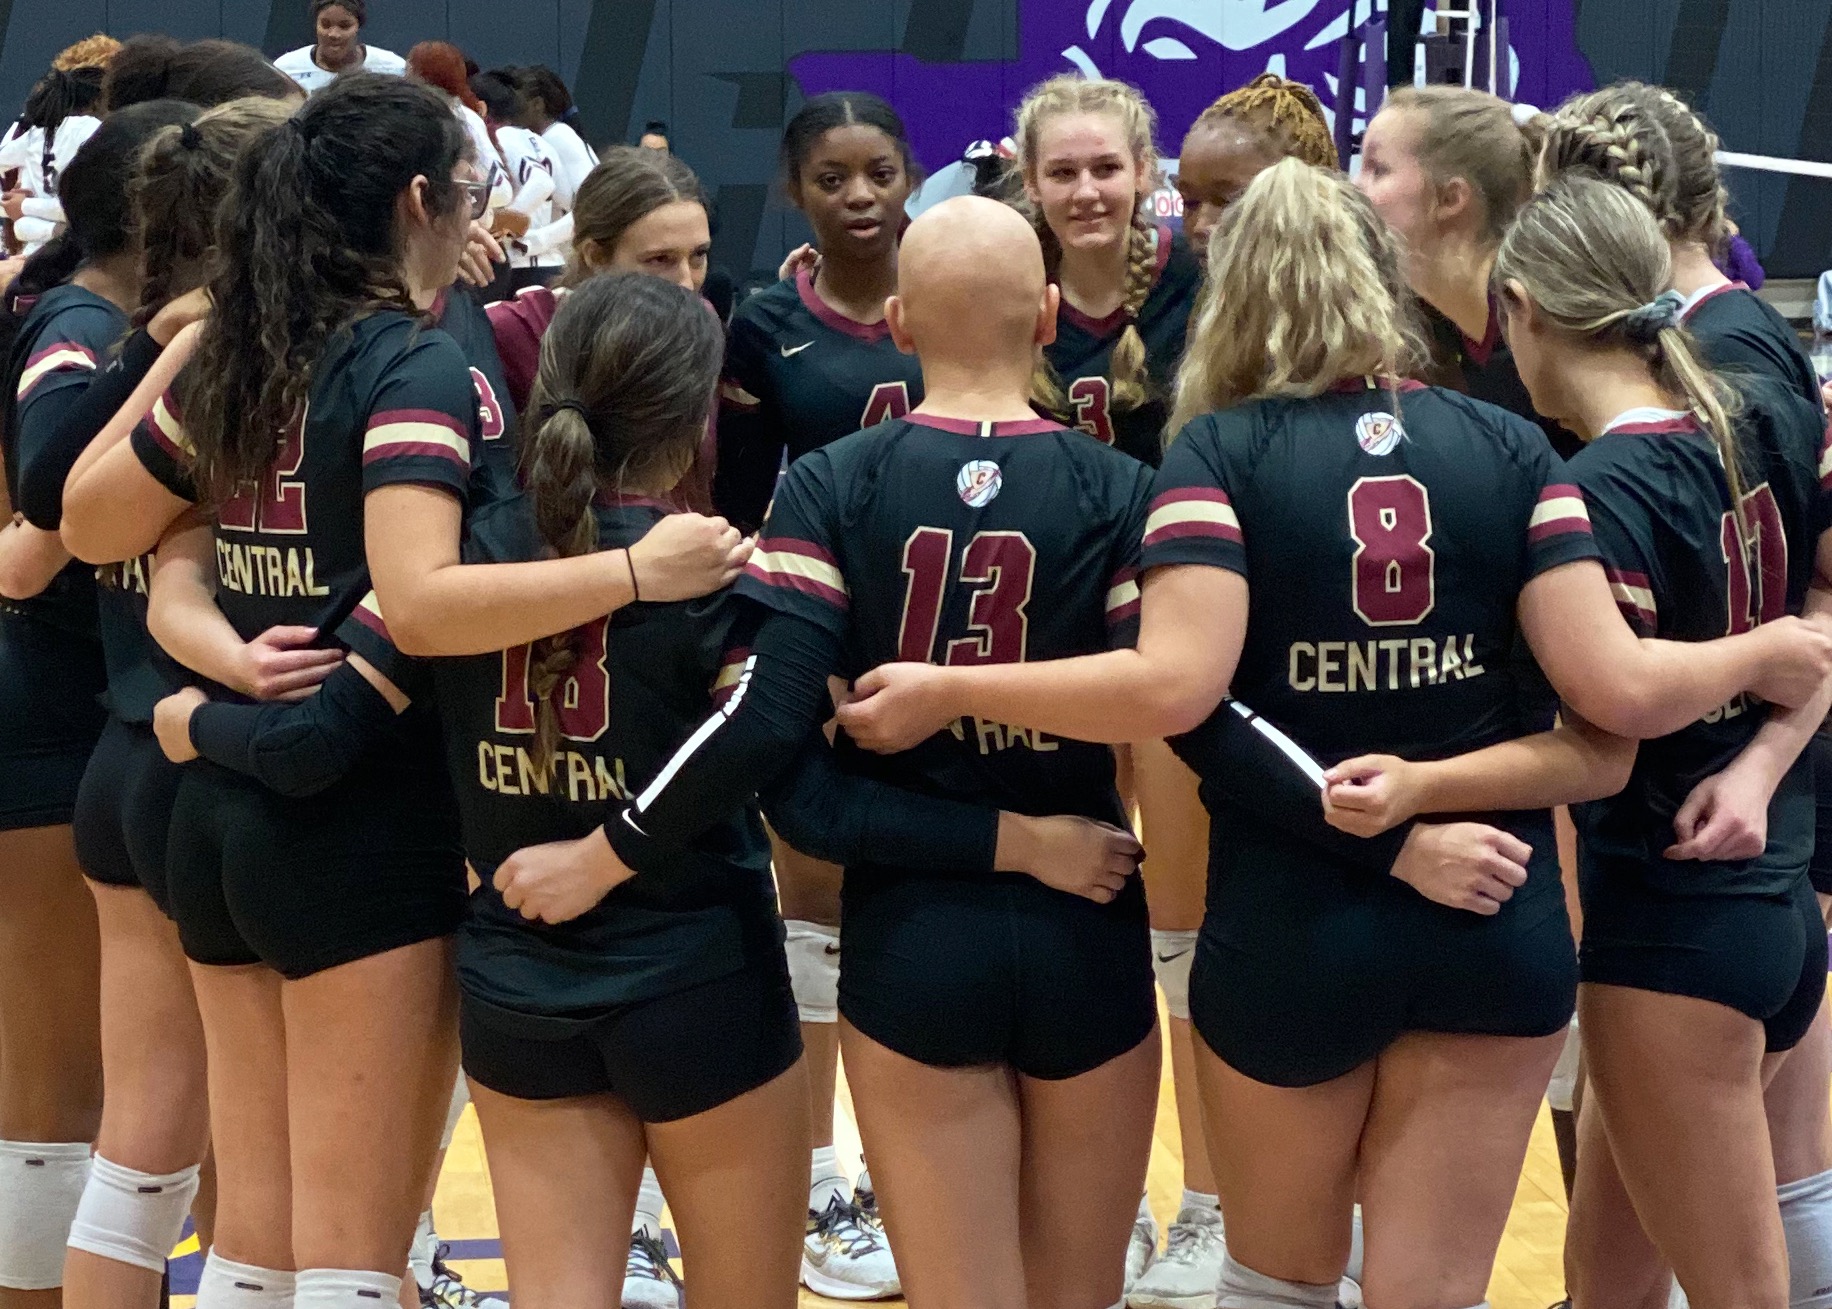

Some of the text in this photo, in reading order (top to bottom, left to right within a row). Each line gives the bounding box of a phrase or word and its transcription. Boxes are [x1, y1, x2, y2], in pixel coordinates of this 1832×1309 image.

[215, 537, 330, 597] CENTRAL
[897, 525, 1037, 667] 13
[1347, 473, 1436, 628] 8
[495, 612, 612, 743] 18
[1288, 633, 1486, 693] CENTRAL
